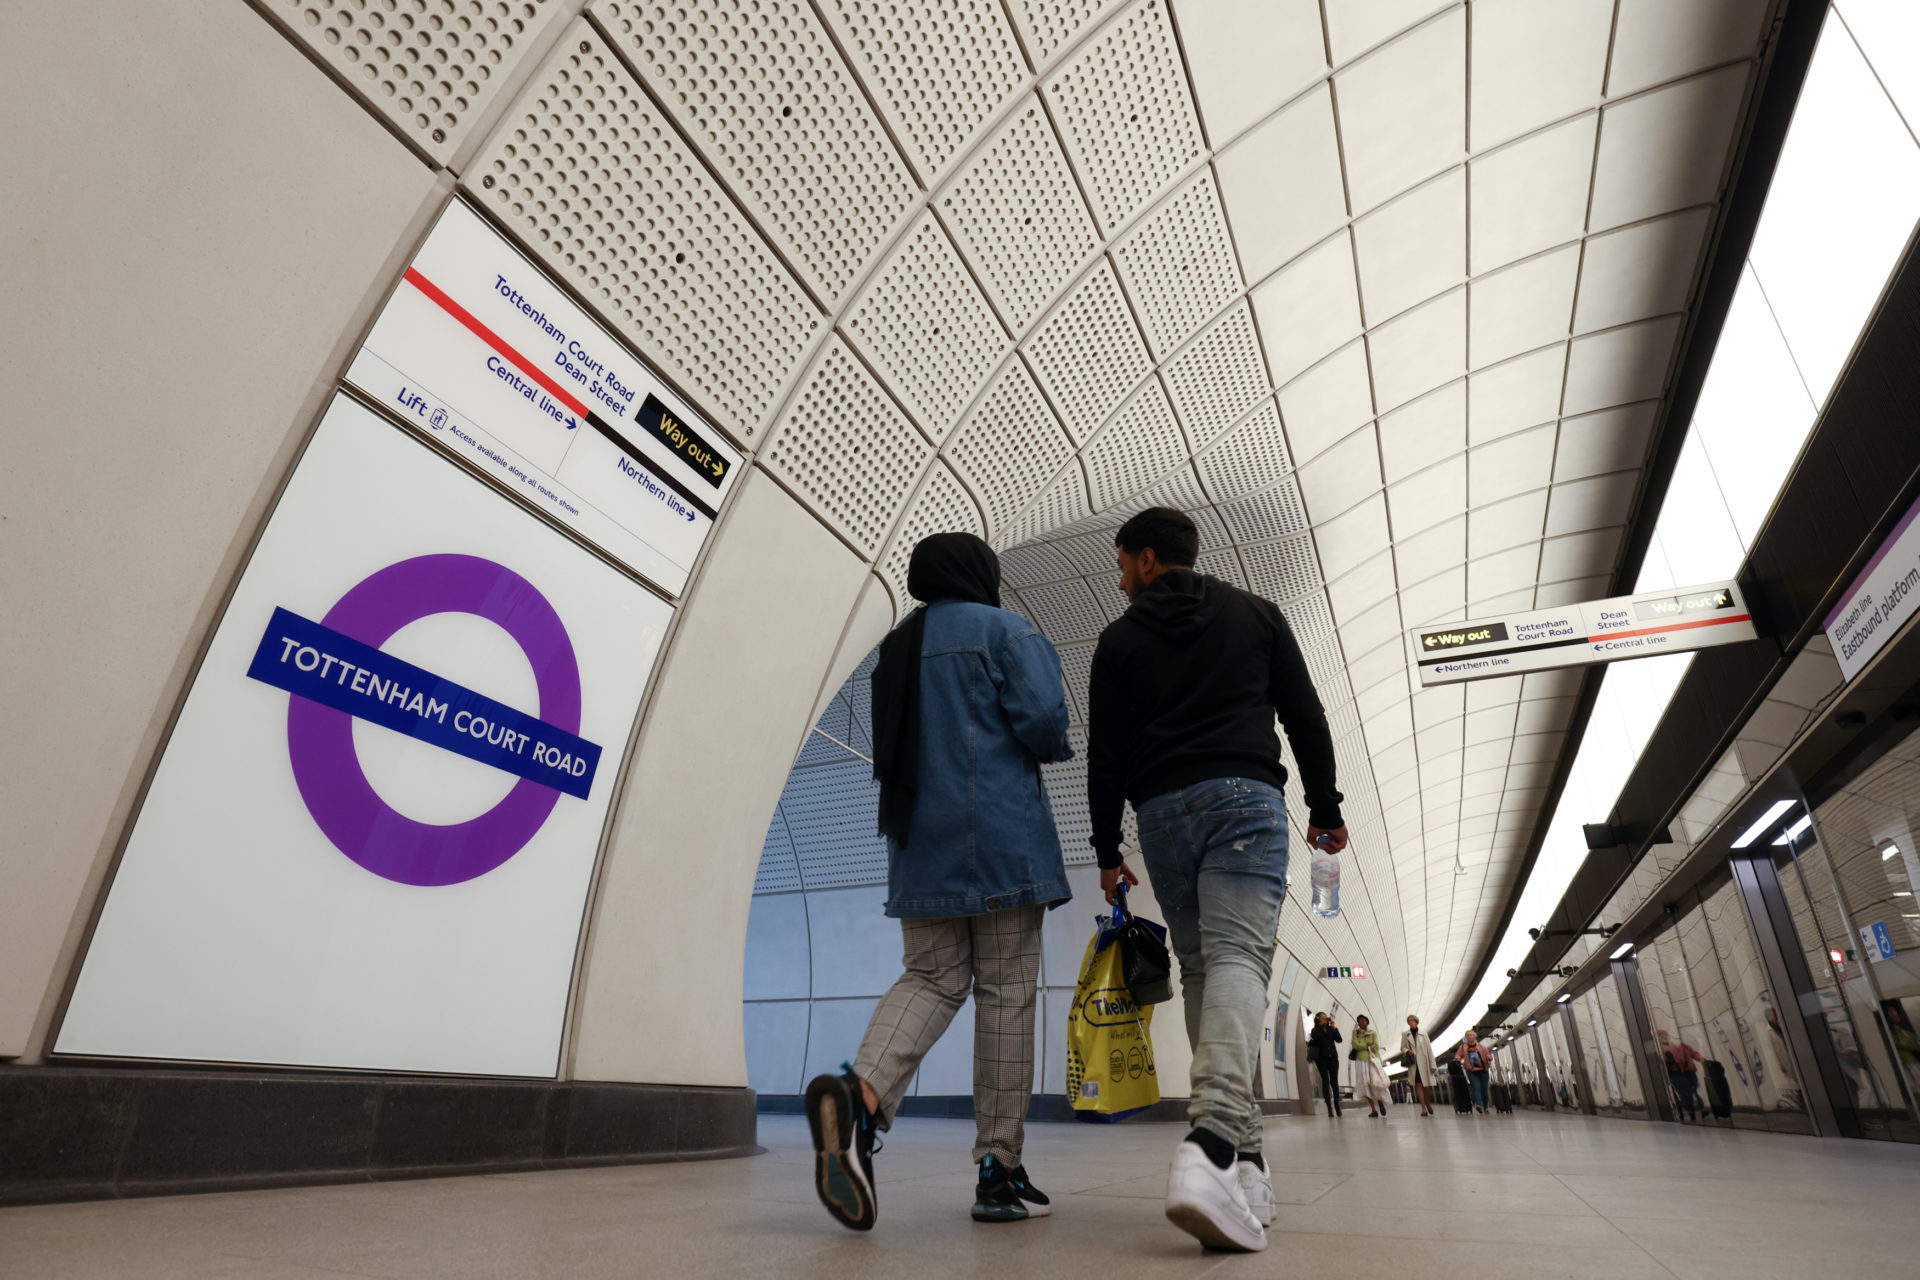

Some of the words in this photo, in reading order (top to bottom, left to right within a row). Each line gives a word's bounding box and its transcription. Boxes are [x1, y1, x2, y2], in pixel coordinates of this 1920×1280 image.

[494, 274, 566, 344] Tottenham
[568, 341, 604, 377] Court
[605, 372, 635, 402] Road
[397, 387, 428, 417] Lift
[487, 356, 538, 402] Central
[539, 396, 563, 422] line
[554, 351, 588, 385] Dean
[589, 380, 626, 417] Street
[659, 413, 689, 449] Way
[688, 444, 712, 468] out
[449, 425, 476, 447] Access
[477, 444, 508, 468] available
[508, 464, 528, 483] along
[527, 476, 537, 488] all
[537, 484, 558, 502] routes
[559, 499, 580, 516] shown
[617, 457, 666, 501] Northern
[667, 495, 686, 516] line
[1597, 619, 1630, 630] Street
[1600, 611, 1628, 620] Dean
[1651, 601, 1684, 614] Way
[1686, 597, 1713, 609] out
[1835, 607, 1861, 642] Elizabeth
[1859, 593, 1872, 615] line
[1841, 609, 1883, 661] Eastbound
[1881, 568, 1920, 621] platform
[1438, 633, 1465, 645] Way
[1467, 629, 1491, 641] out
[1514, 620, 1568, 632] Tottenham
[1517, 631, 1546, 641] Court
[1549, 627, 1574, 637] Road
[1605, 639, 1644, 650] Central
[1646, 636, 1667, 645] line
[1445, 660, 1489, 673] Northern
[1491, 658, 1510, 666] line
[280, 636, 448, 724] TOTTENHAM
[453, 711, 530, 755] COURT
[532, 741, 587, 777] ROAD
